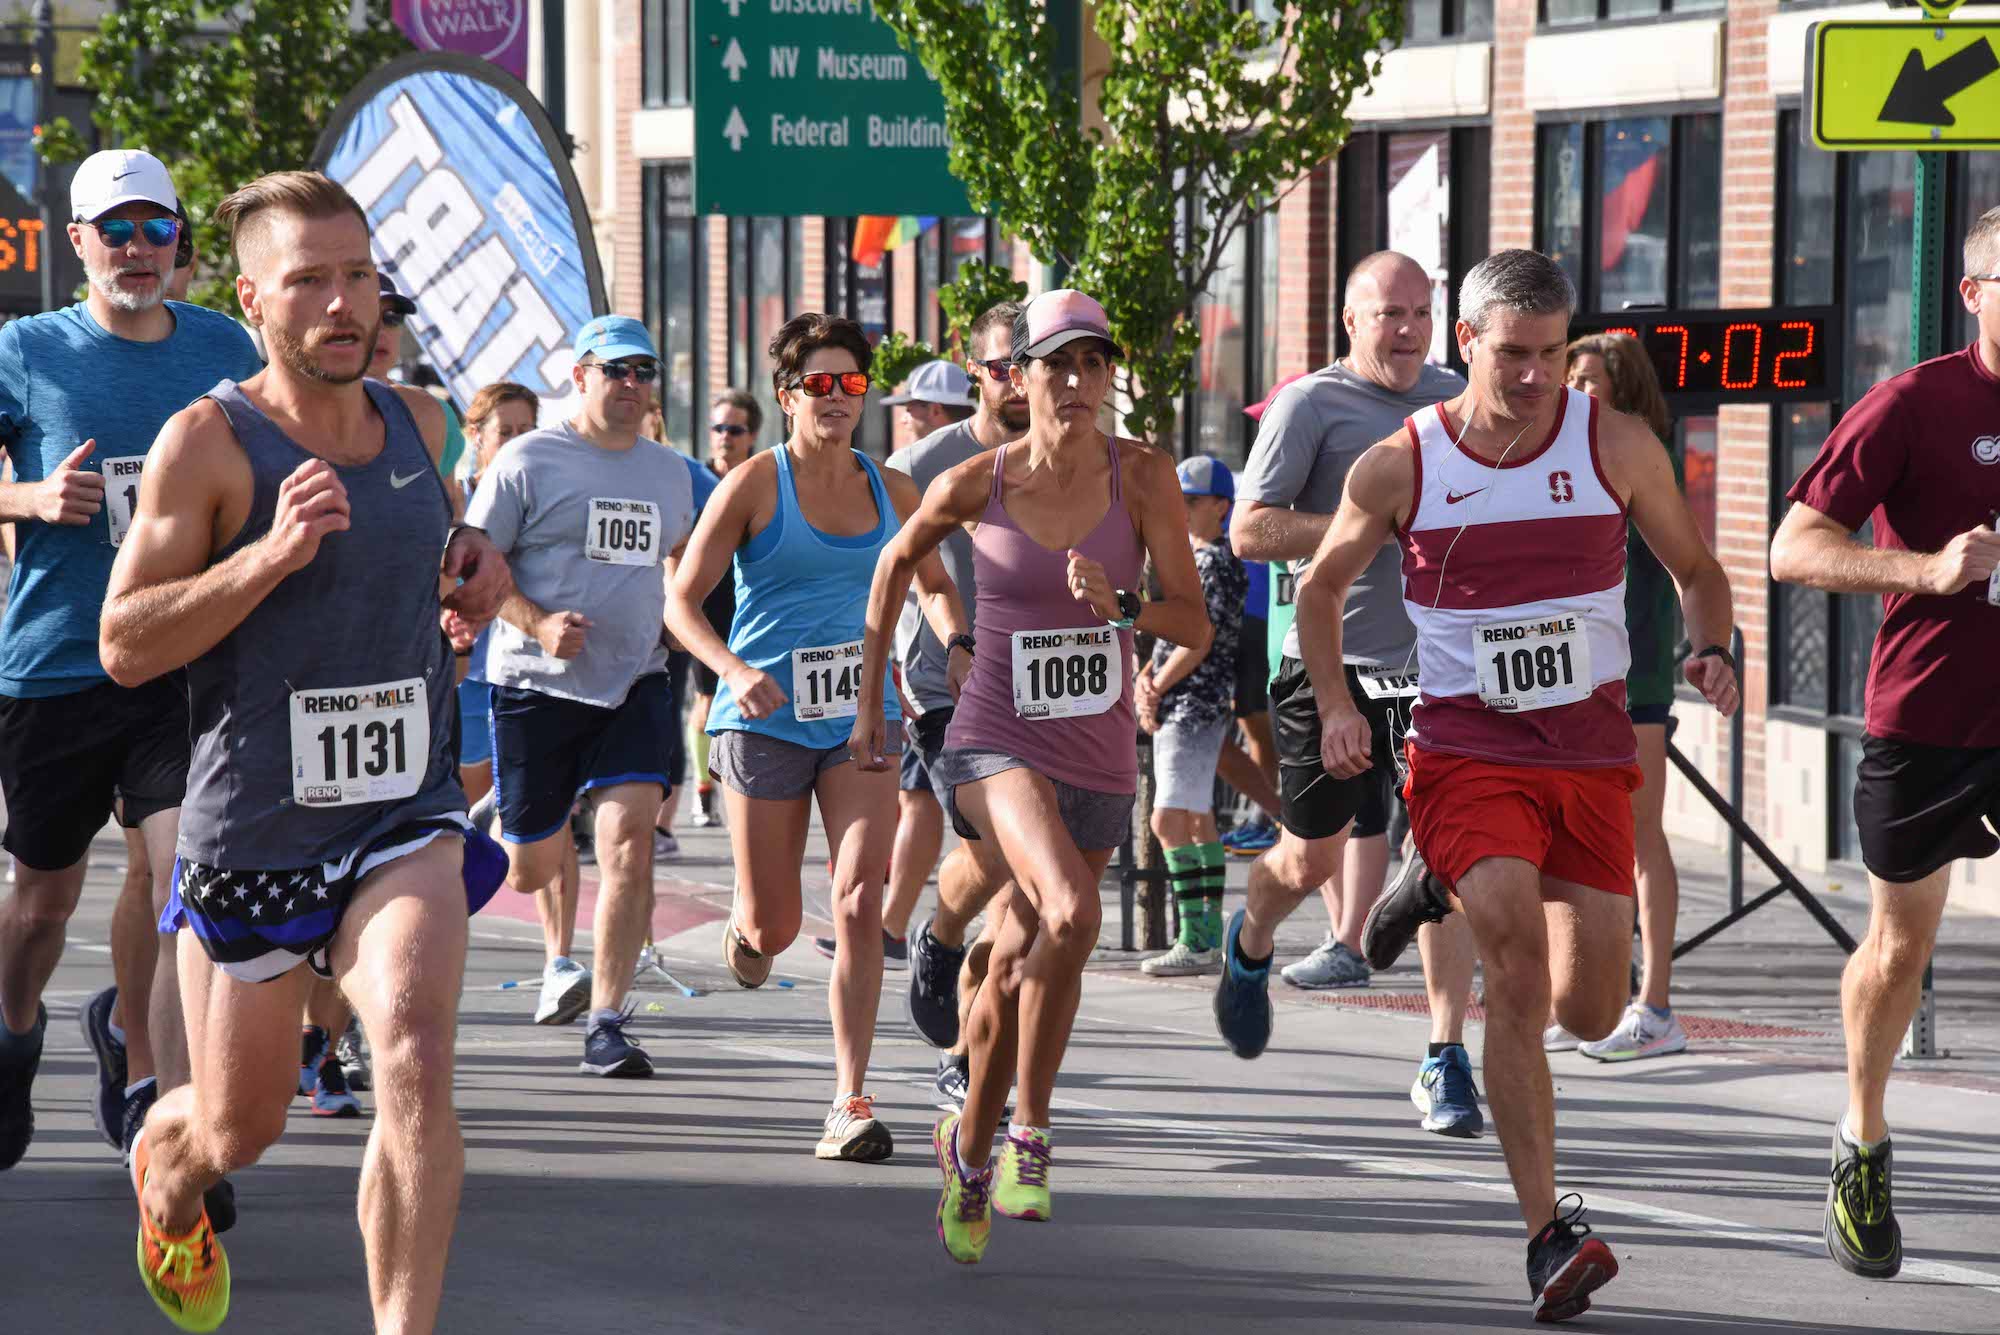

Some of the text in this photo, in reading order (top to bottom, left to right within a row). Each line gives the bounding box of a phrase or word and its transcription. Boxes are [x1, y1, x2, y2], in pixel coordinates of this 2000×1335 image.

[431, 9, 512, 36] WALK
[770, 46, 799, 78] NV
[817, 47, 907, 80] Museum
[771, 114, 849, 146] Federal
[596, 501, 622, 512] RENO
[598, 518, 651, 552] 1095
[1023, 634, 1063, 650] RENO
[1483, 626, 1526, 643] RENO
[801, 650, 834, 663] RENO
[1492, 642, 1573, 694] 1081
[806, 663, 863, 705] 1149
[1026, 653, 1108, 701] 1088
[304, 694, 358, 714] RENO
[1024, 704, 1048, 714] RENO
[1490, 697, 1516, 707] RENO
[317, 717, 406, 782] 1131
[307, 786, 340, 798] RENO
